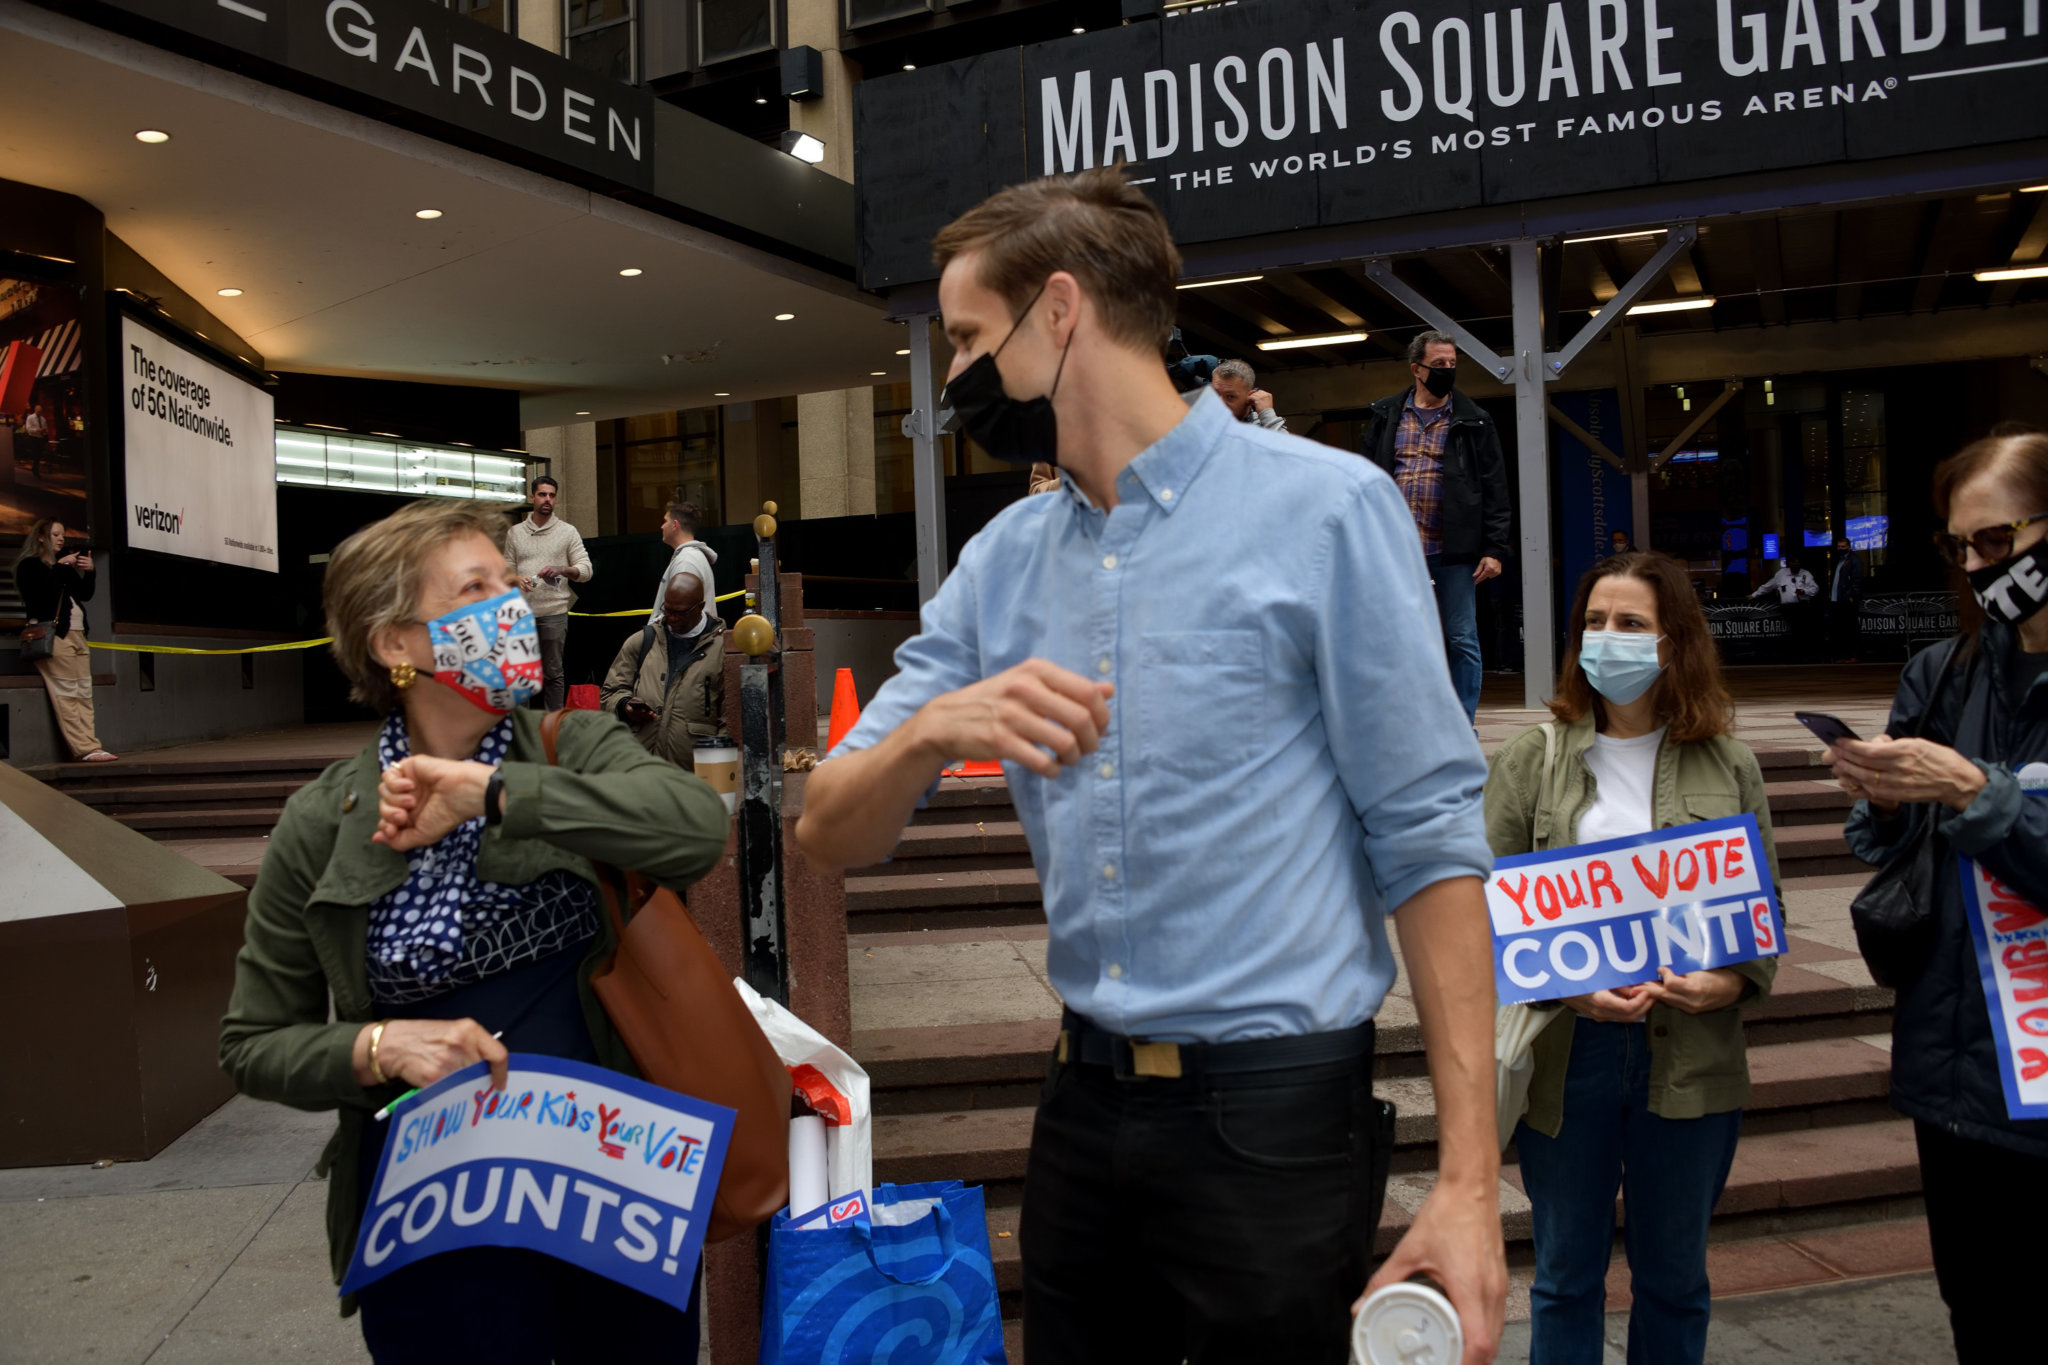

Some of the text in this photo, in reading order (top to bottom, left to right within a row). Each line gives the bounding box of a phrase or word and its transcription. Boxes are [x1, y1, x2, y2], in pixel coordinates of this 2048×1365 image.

[325, 0, 642, 162] GARDEN
[1041, 37, 1347, 176] MADISON
[1379, 0, 1682, 121] SQUARE
[1170, 165, 1234, 191] THE
[1250, 139, 1413, 180] WORLD'S
[1431, 122, 1537, 154] MOST
[1556, 100, 1722, 139] FAMOUS
[131, 343, 210, 410] The coverage
[131, 384, 233, 447] of 5G Nationwide.
[135, 502, 180, 535] verizon
[1497, 836, 1746, 927] YOUR VOTE
[396, 1100, 467, 1163] SHOW
[471, 1082, 534, 1127] YOUR
[643, 1121, 705, 1176] VOTE
[363, 1166, 690, 1277] COUNTS!
